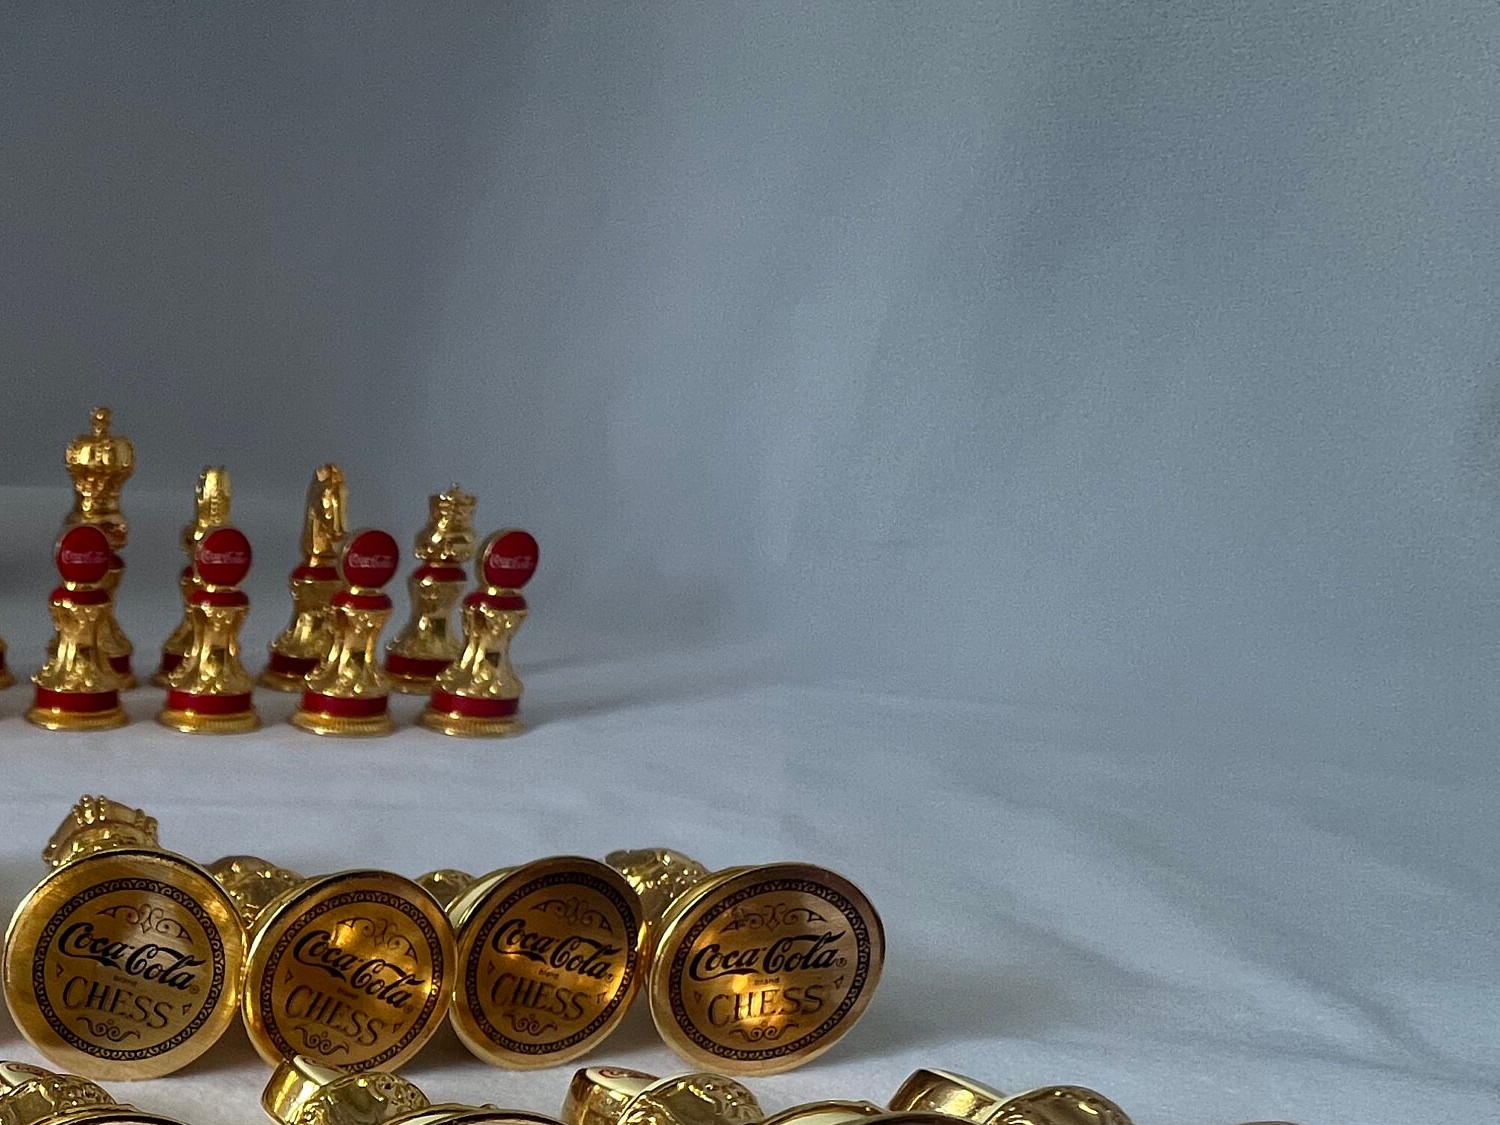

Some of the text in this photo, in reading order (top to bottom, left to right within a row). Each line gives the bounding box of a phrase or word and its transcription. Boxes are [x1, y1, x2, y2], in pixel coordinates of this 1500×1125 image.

[62, 976, 173, 1029] CHESS
[285, 984, 384, 1046] CHESS
[491, 972, 590, 1021] CHESS
[707, 984, 825, 1027] CHESS
